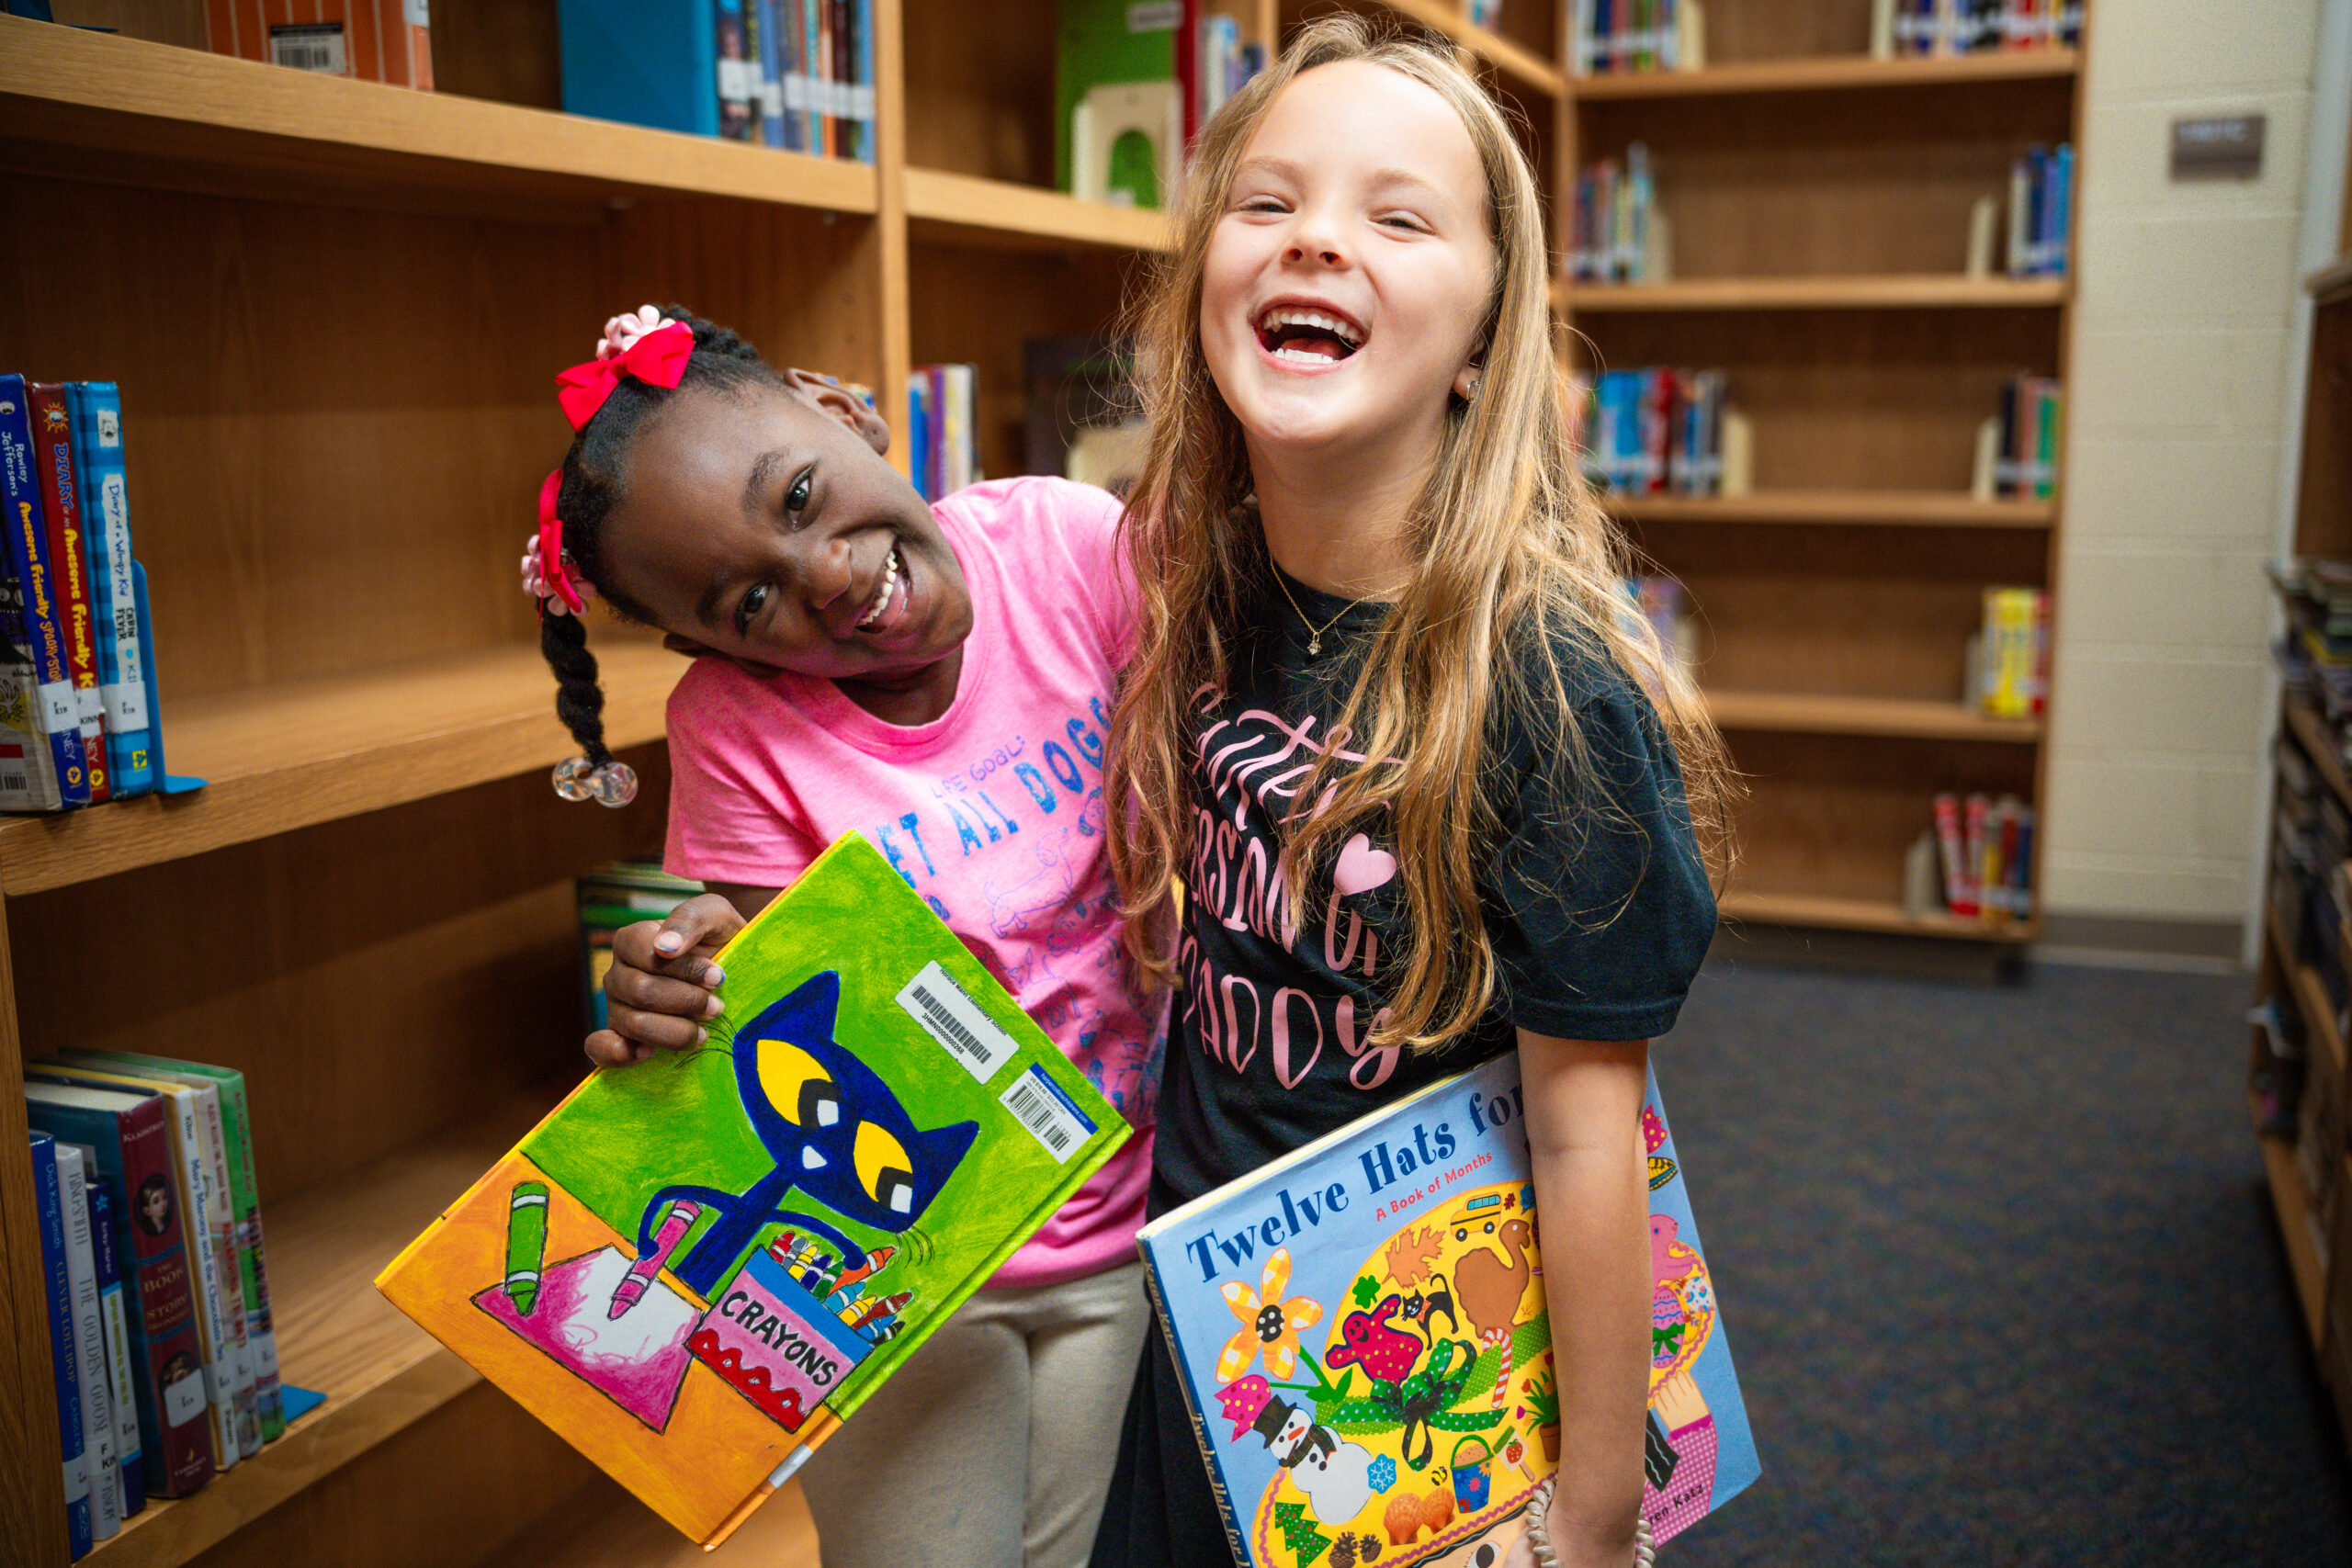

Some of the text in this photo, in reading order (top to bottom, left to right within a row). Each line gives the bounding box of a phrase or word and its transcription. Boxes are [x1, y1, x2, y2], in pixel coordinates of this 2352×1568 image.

[2, 432, 17, 497] Jefferson's
[15, 443, 28, 483] Rowley
[54, 443, 74, 510] DIARY
[108, 484, 121, 518] Diary
[64, 528, 82, 599] Awesome
[115, 538, 125, 576] Wimpy
[18, 502, 63, 683] Awesome Friendly SPOOKY STOR
[119, 579, 130, 597] Kid
[72, 603, 91, 669] Friendly
[116, 608, 127, 641] FEVER
[126, 606, 136, 638] CABIN
[928, 774, 967, 799] LIFE
[876, 811, 935, 889] ET
[944, 790, 1020, 858] ALL
[939, 968, 956, 986] Horace
[956, 984, 968, 998] Mann
[967, 996, 993, 1021] Elementary
[922, 1012, 965, 1055] 3HMN0000000268
[46, 1162, 55, 1191] Dick
[1185, 1083, 1524, 1283] Twelve Hats for
[1375, 1152, 1492, 1223] A Book of Months
[56, 1261, 69, 1315] CLEVER
[79, 1279, 95, 1307] THE
[62, 1319, 74, 1382] LOLLIPOP
[83, 1314, 103, 1377] GOLDEN
[720, 1291, 839, 1386] CRAYONS
[90, 1383, 108, 1435] GOOSE
[101, 1443, 107, 1455] F
[1648, 1483, 1703, 1525] ren Katz
